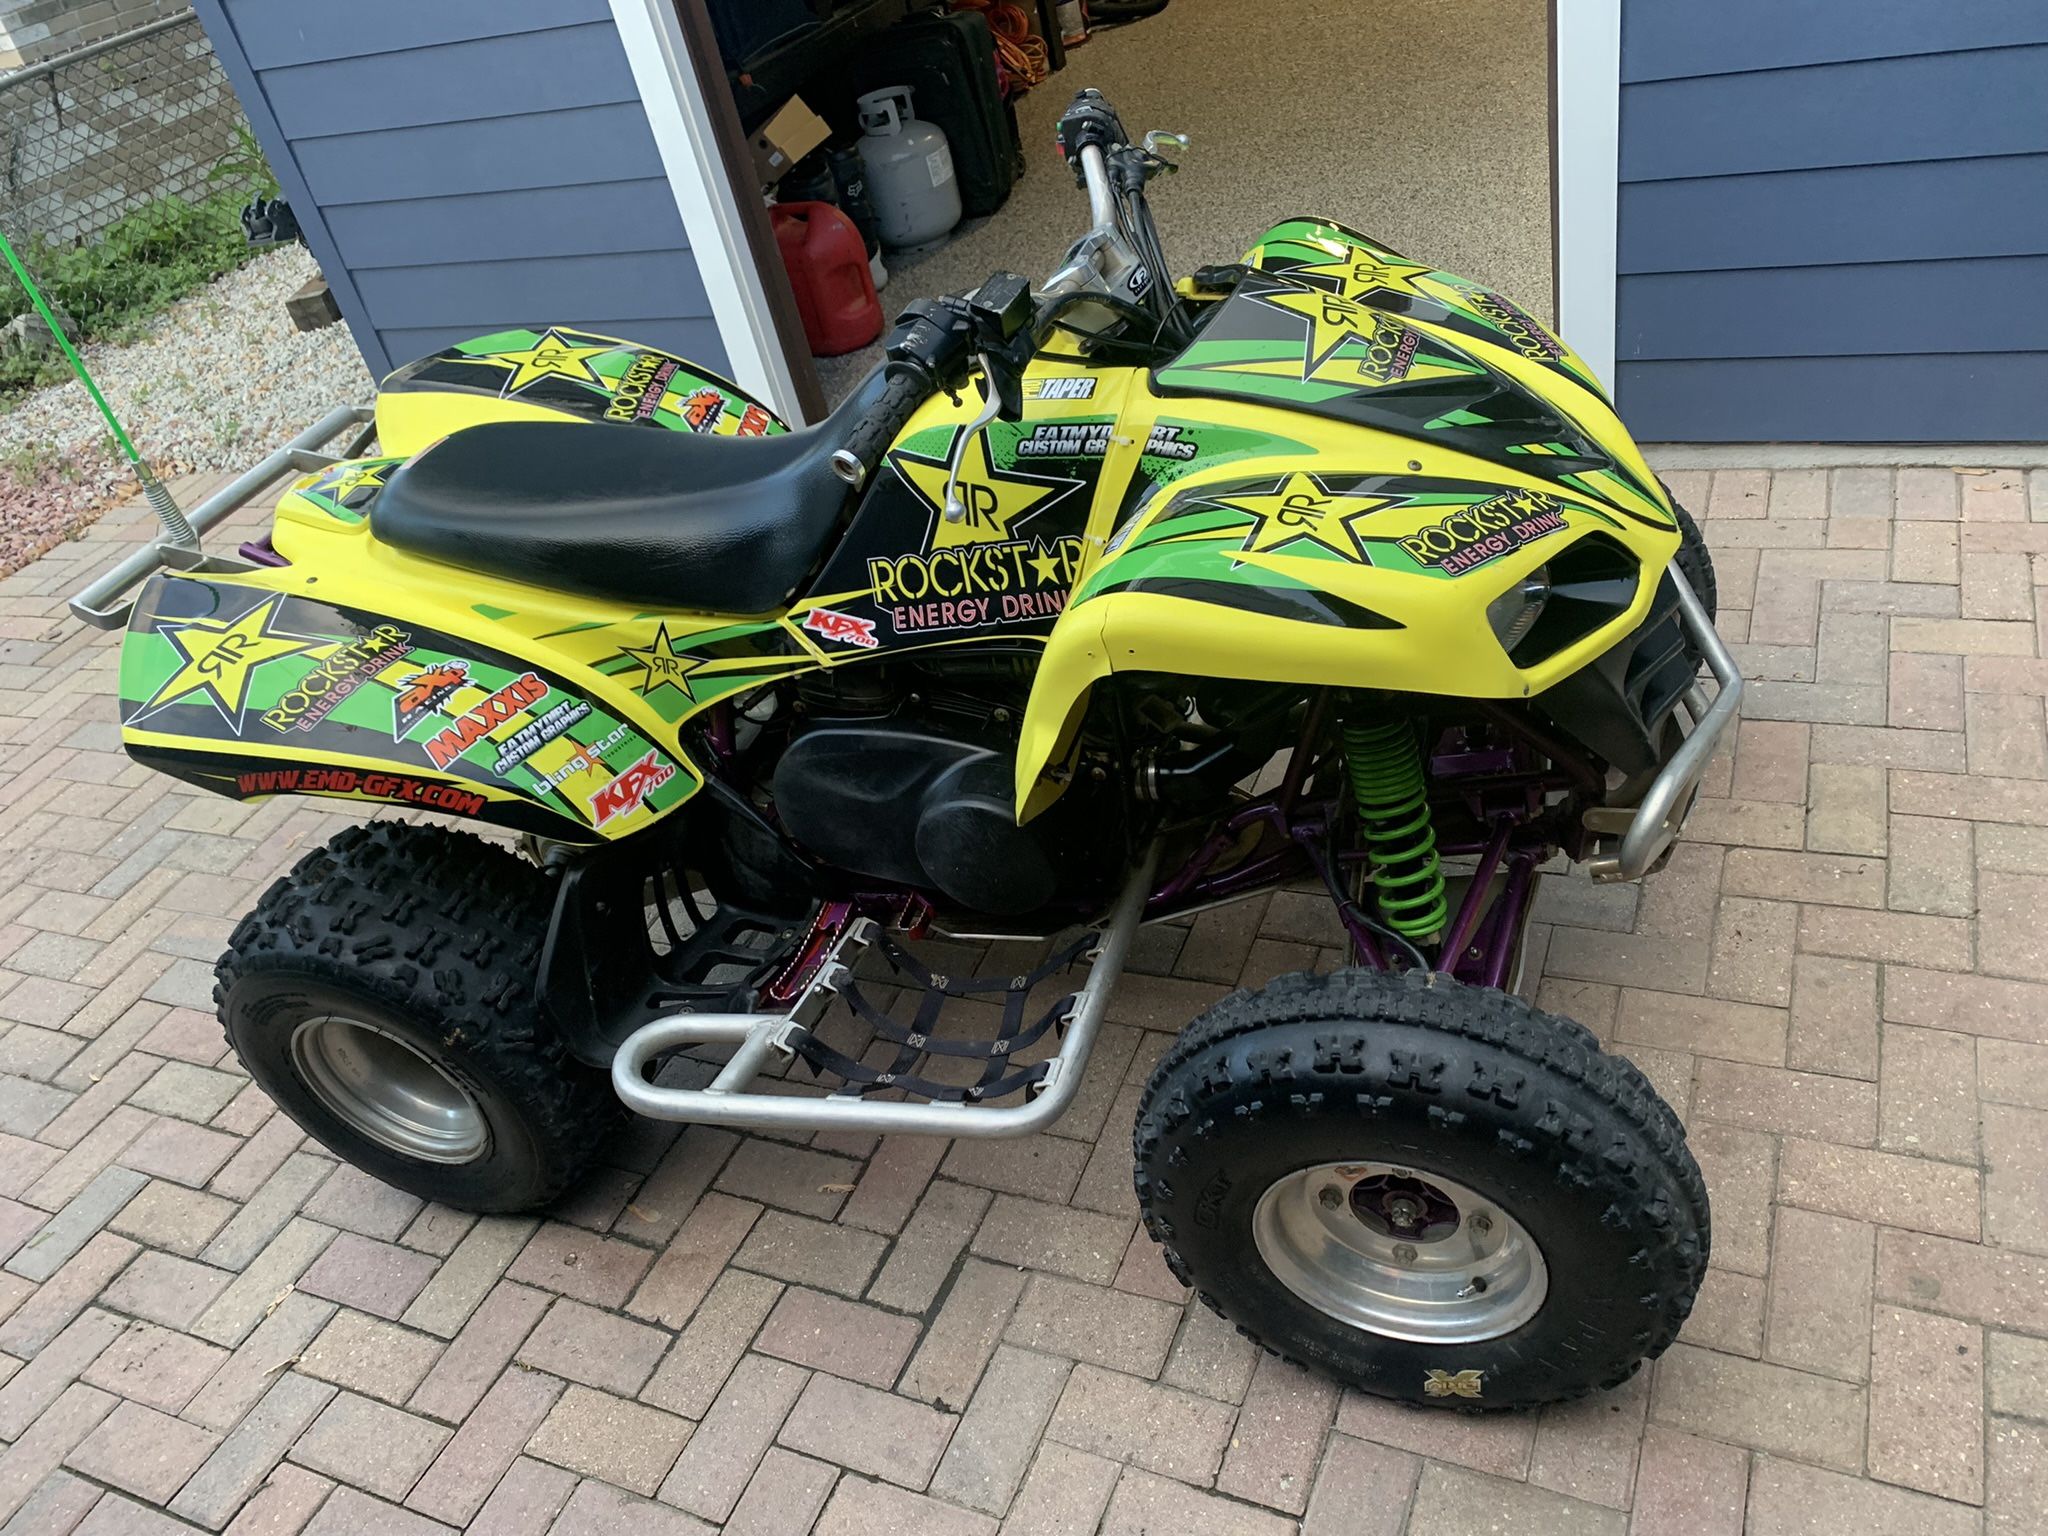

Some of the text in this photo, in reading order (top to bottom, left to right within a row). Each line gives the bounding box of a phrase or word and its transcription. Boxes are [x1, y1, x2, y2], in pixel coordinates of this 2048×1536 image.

[637, 381, 665, 418] ENERGY
[1018, 439, 1196, 459] CUSTOM GRPHICS
[1034, 425, 1180, 441] EATMYDRT
[1442, 511, 1564, 574] ENERGY DRINK
[806, 610, 873, 638] KFX
[893, 598, 989, 630] ENERGY
[845, 633, 877, 647] 700
[297, 676, 360, 732] ENERGY
[360, 642, 413, 680] DRINK
[426, 676, 548, 770] MAXXIS
[495, 702, 591, 775] CUSTOM GRAPHICS
[498, 701, 573, 756] EATMYDIRT
[584, 724, 629, 761] star
[237, 770, 486, 816] WWW.EMD-GFX.COM
[595, 751, 661, 827] KFX
[645, 764, 676, 794] 700
